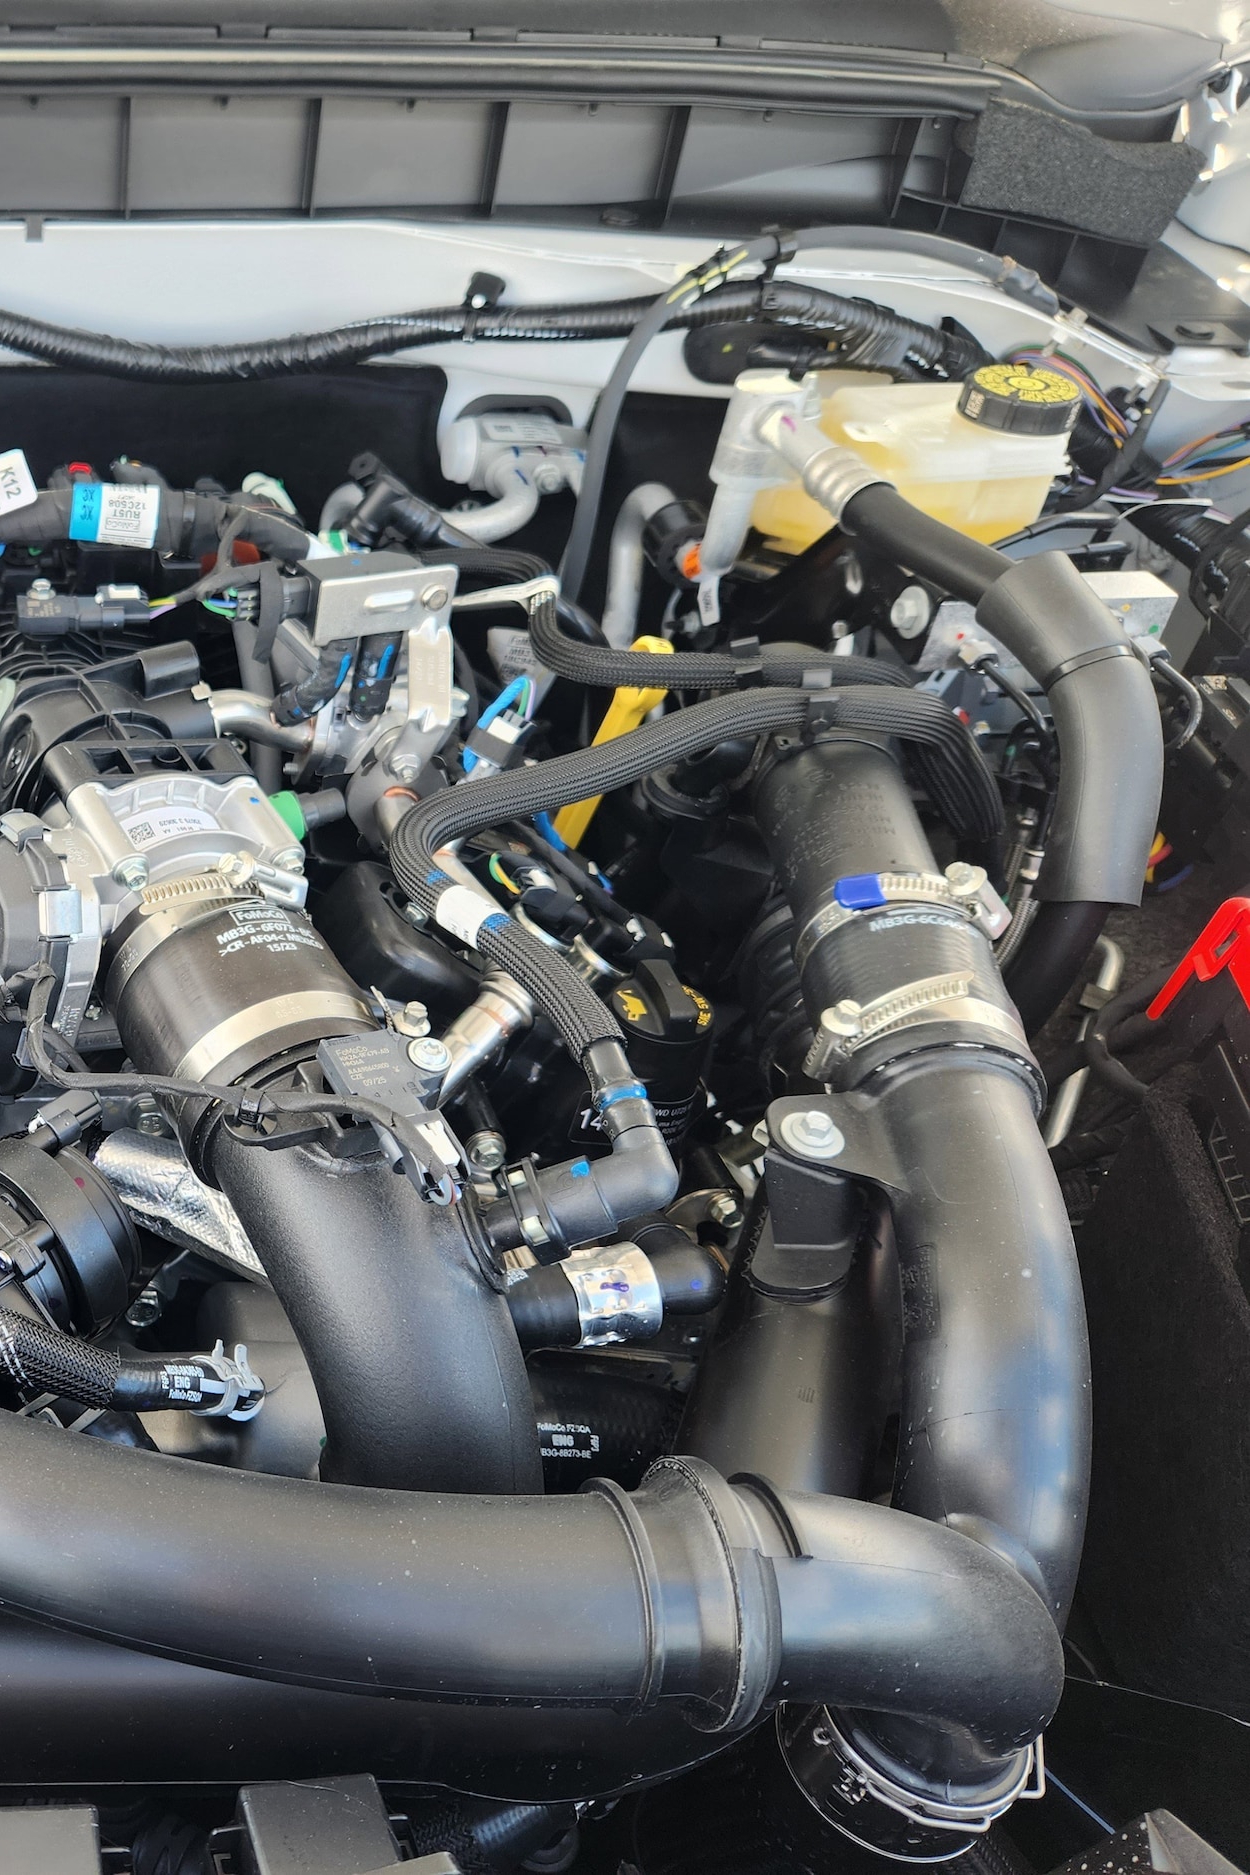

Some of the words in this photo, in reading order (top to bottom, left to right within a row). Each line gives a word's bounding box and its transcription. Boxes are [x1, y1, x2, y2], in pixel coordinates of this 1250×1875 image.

[108, 499, 147, 511] 12C508
[235, 910, 284, 921] FoMoCo
[266, 942, 298, 952] 15/23
[285, 933, 325, 950] MEXICO
[696, 1012, 711, 1027] SAE
[335, 1045, 368, 1057] FoMoCo
[174, 1375, 191, 1390] ENG
[536, 1422, 566, 1432] FoMoCo
[551, 1434, 575, 1447] ENG
[539, 1447, 593, 1460] B3G-8B273-BE
